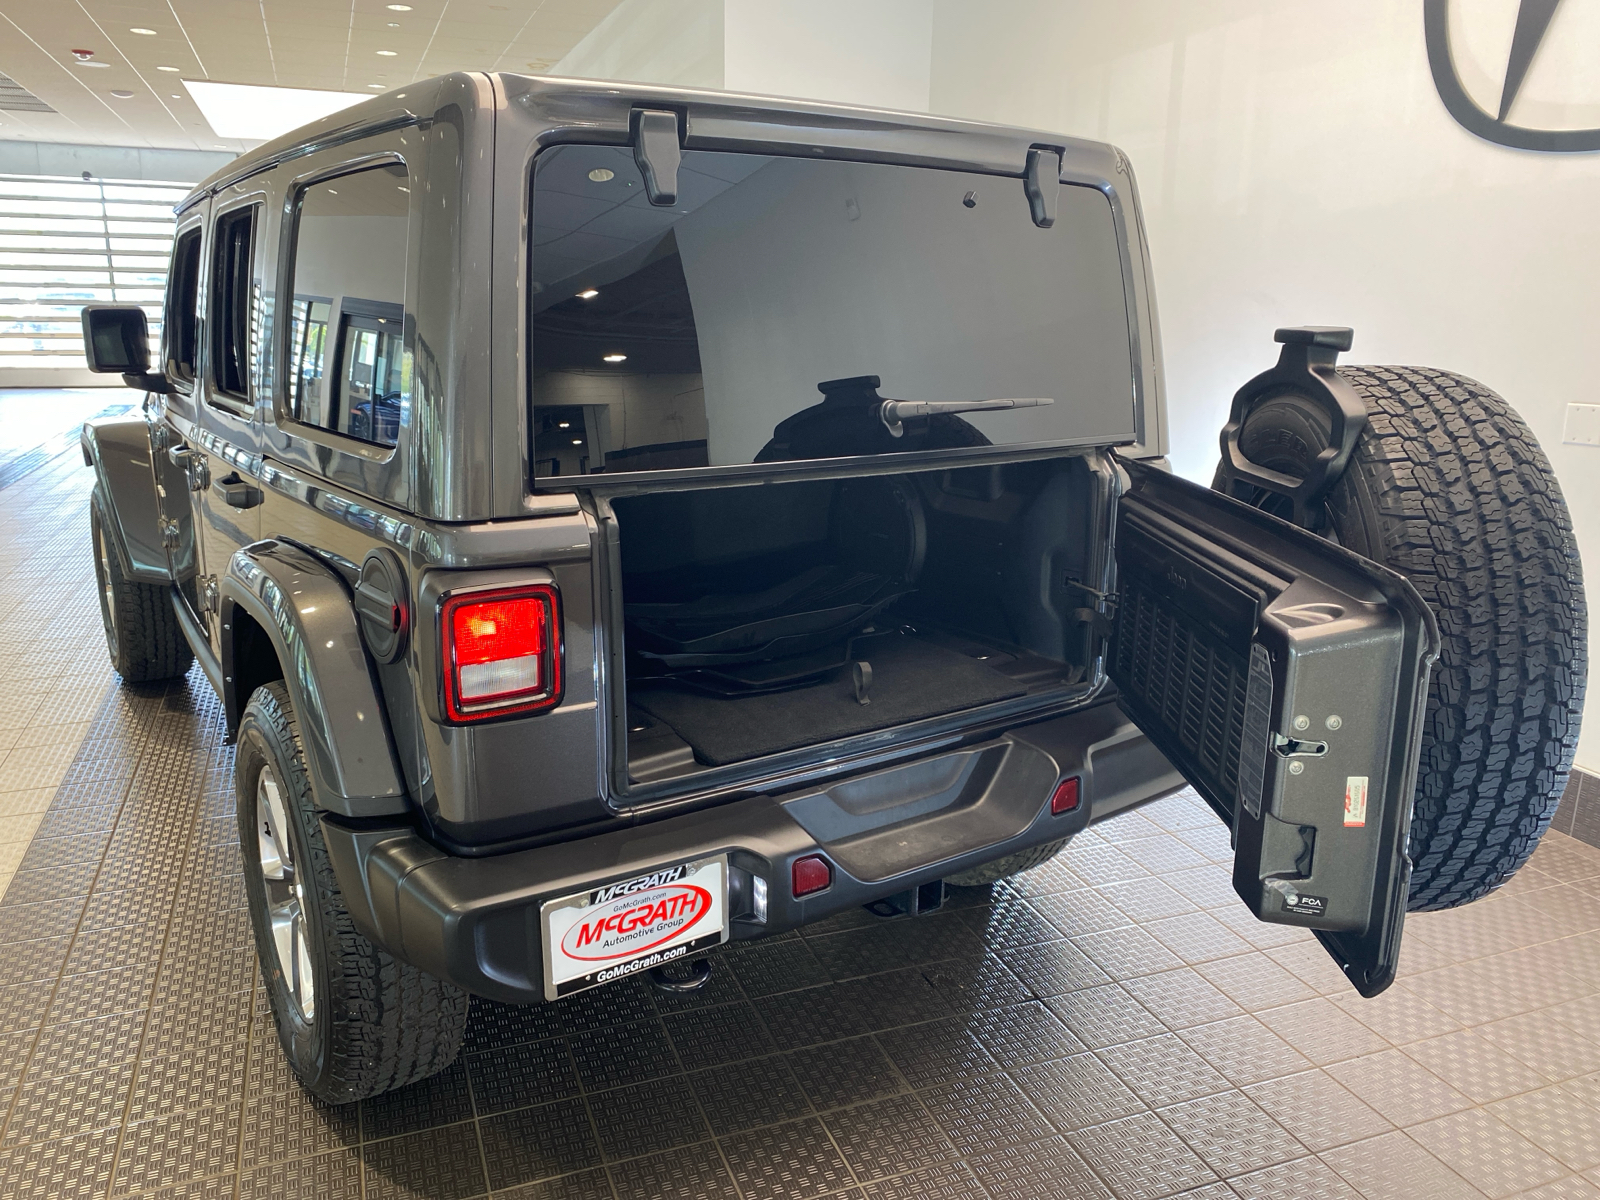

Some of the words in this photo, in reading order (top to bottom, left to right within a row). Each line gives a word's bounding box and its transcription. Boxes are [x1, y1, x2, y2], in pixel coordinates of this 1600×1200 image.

[613, 892, 667, 912] GoMcGrath.com
[1302, 897, 1321, 906] FCA
[602, 928, 654, 948] Automotive
[657, 918, 684, 932] Group
[597, 945, 687, 983] GoMcGrath.com
